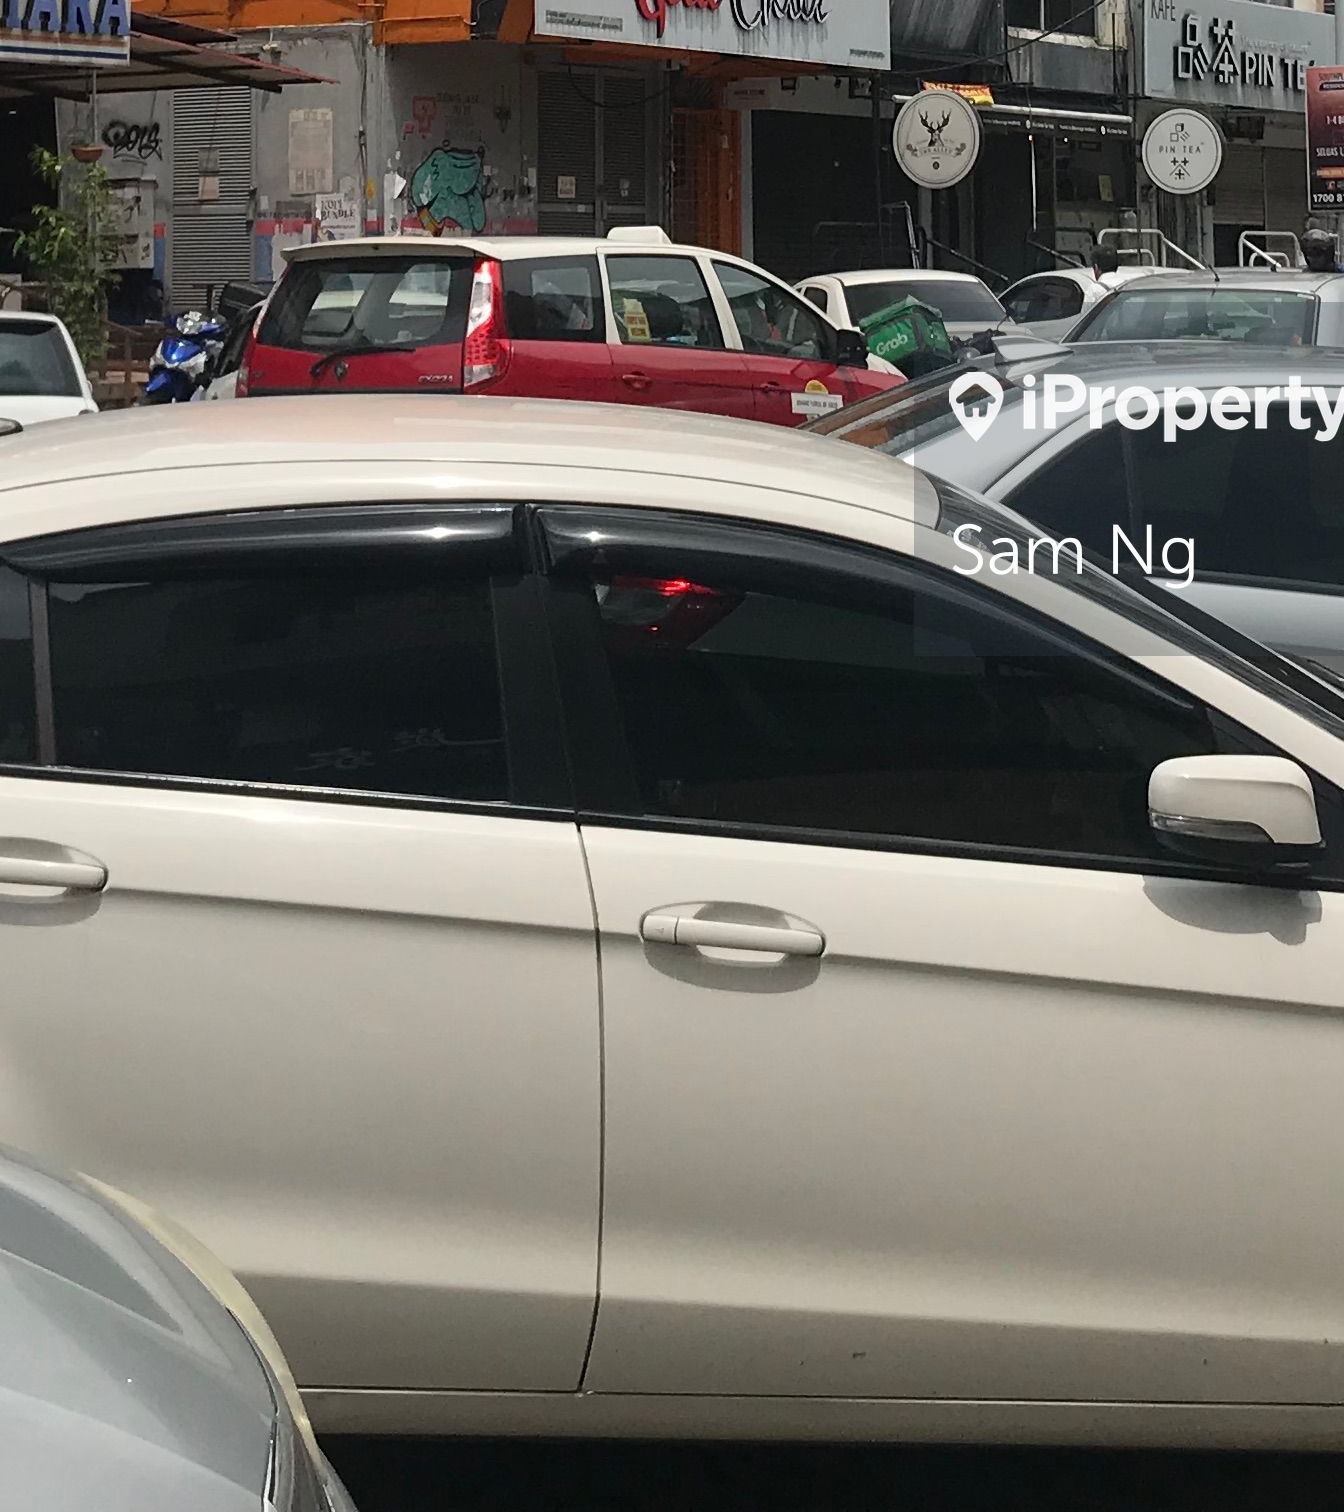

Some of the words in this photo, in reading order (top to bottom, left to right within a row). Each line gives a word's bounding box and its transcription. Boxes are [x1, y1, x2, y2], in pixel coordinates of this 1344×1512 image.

[1243, 51, 1275, 87] PIN
[1282, 57, 1310, 90] TE
[1159, 144, 1176, 154] PIN
[1183, 144, 1201, 154] TEA
[1313, 193, 1335, 203] 1700
[876, 333, 908, 356] Grab
